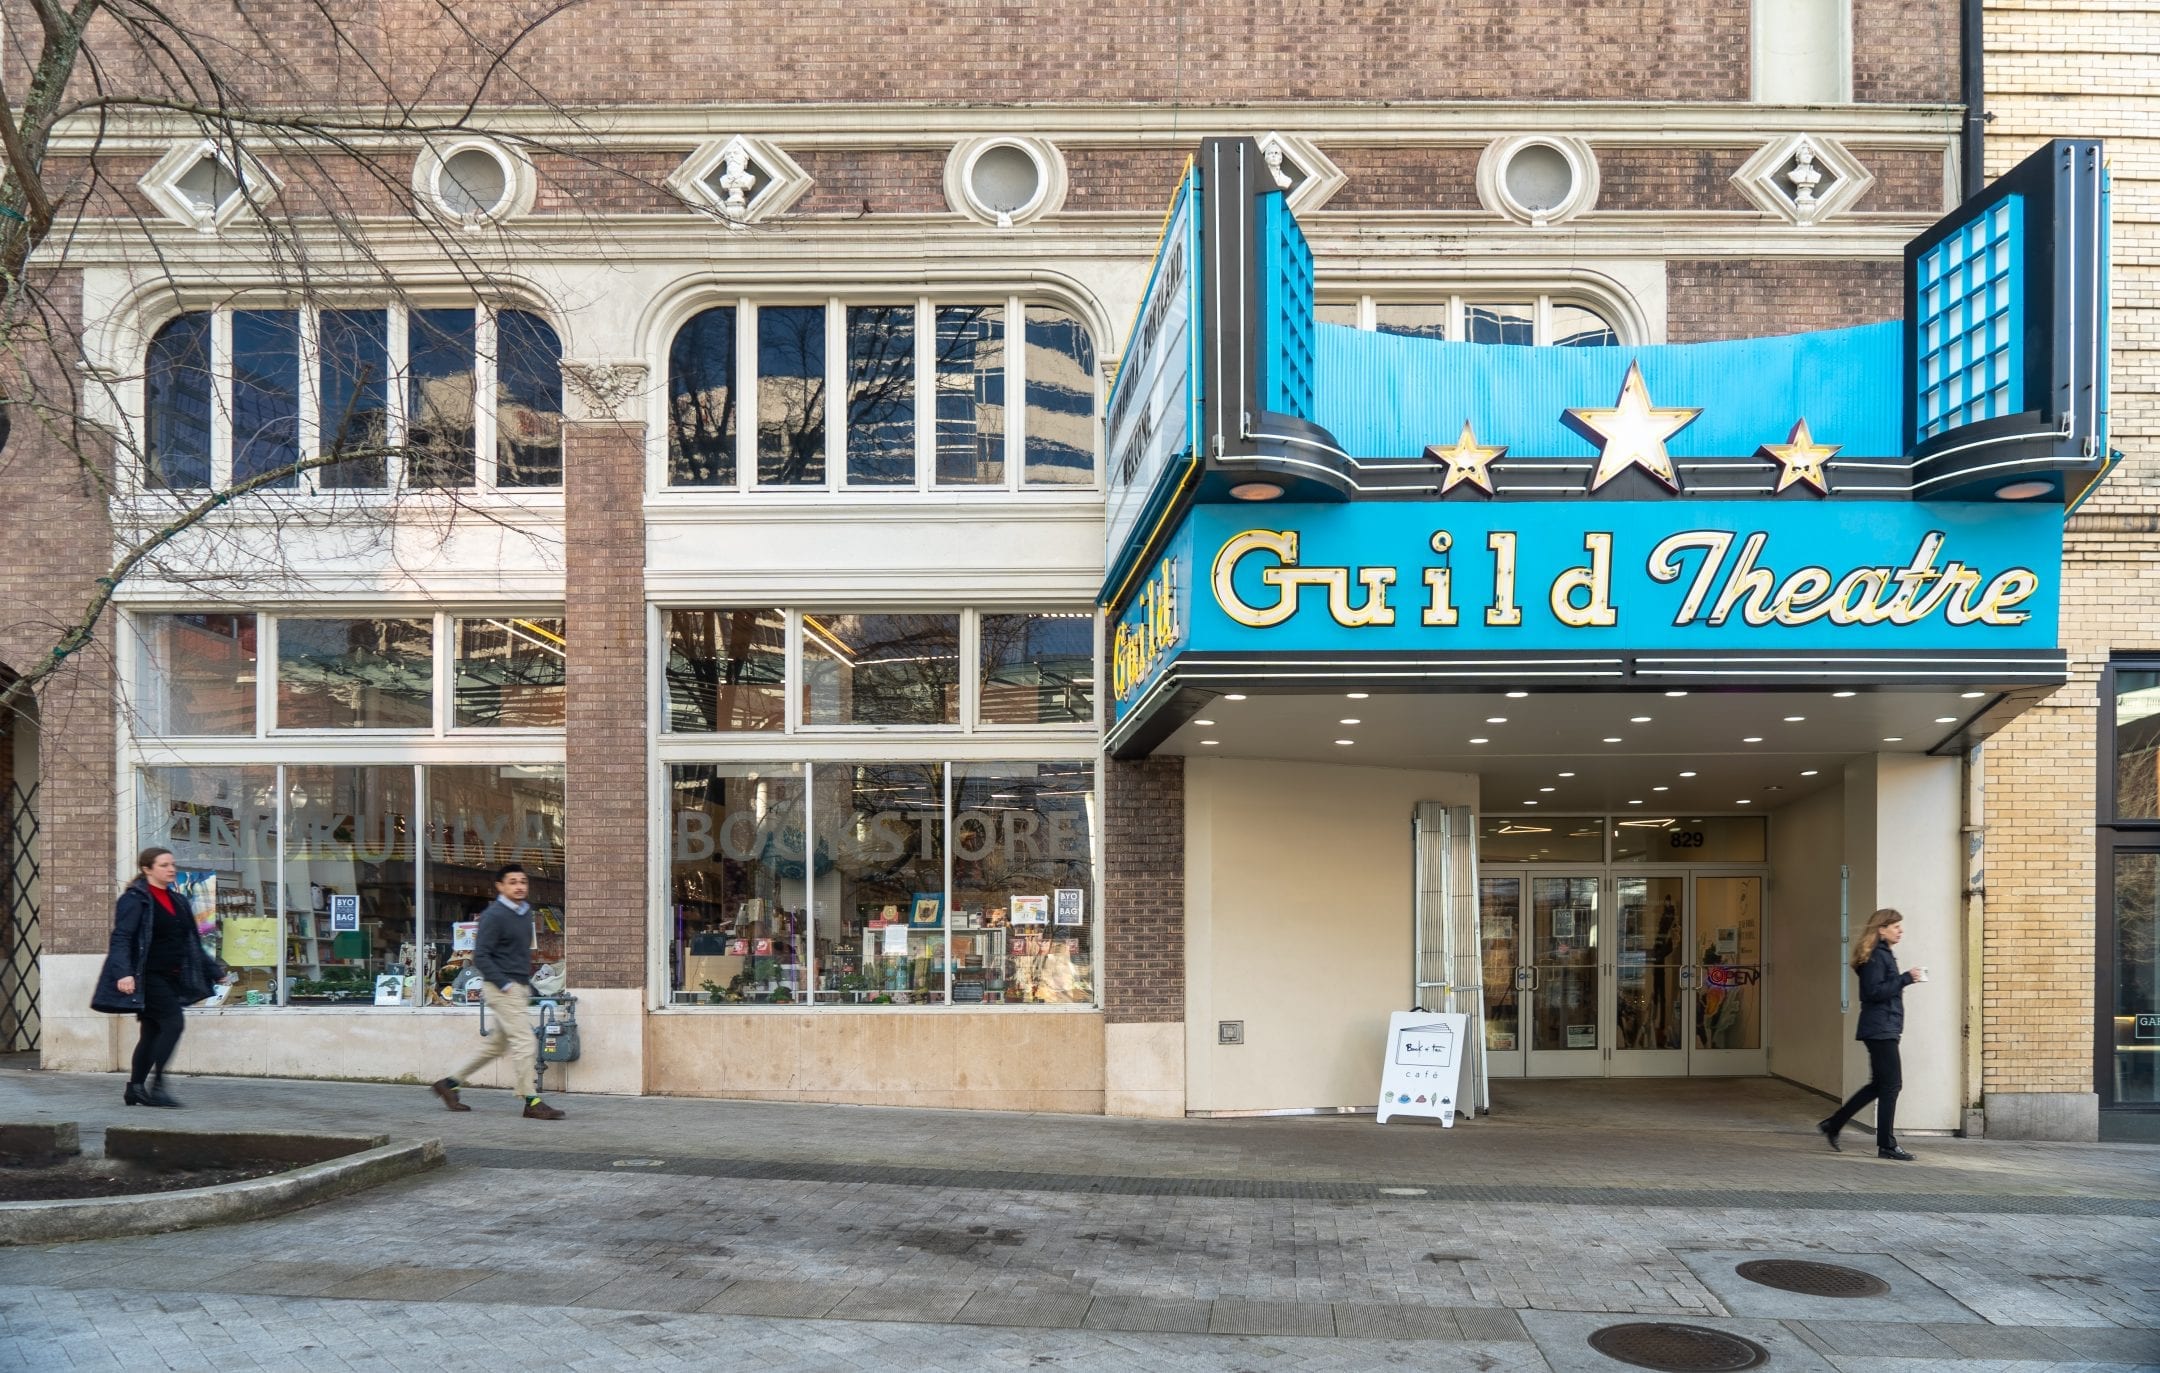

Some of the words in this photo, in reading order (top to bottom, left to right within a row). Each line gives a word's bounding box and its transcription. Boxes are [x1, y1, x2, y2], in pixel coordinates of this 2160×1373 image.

[1143, 242, 1182, 362] PORTLAND
[1123, 404, 1152, 487] WELCOME
[1211, 529, 1617, 628] Guild
[1645, 529, 2038, 628] Theatre
[1113, 556, 1179, 704] Guild
[677, 811, 1080, 862] BOOKSTORE
[1671, 832, 1704, 848] 829
[336, 898, 355, 906] BYO
[1060, 892, 1078, 900] BYO
[336, 913, 355, 921] BAG
[1060, 907, 1078, 915] BAG
[1711, 967, 1755, 986] OPEN
